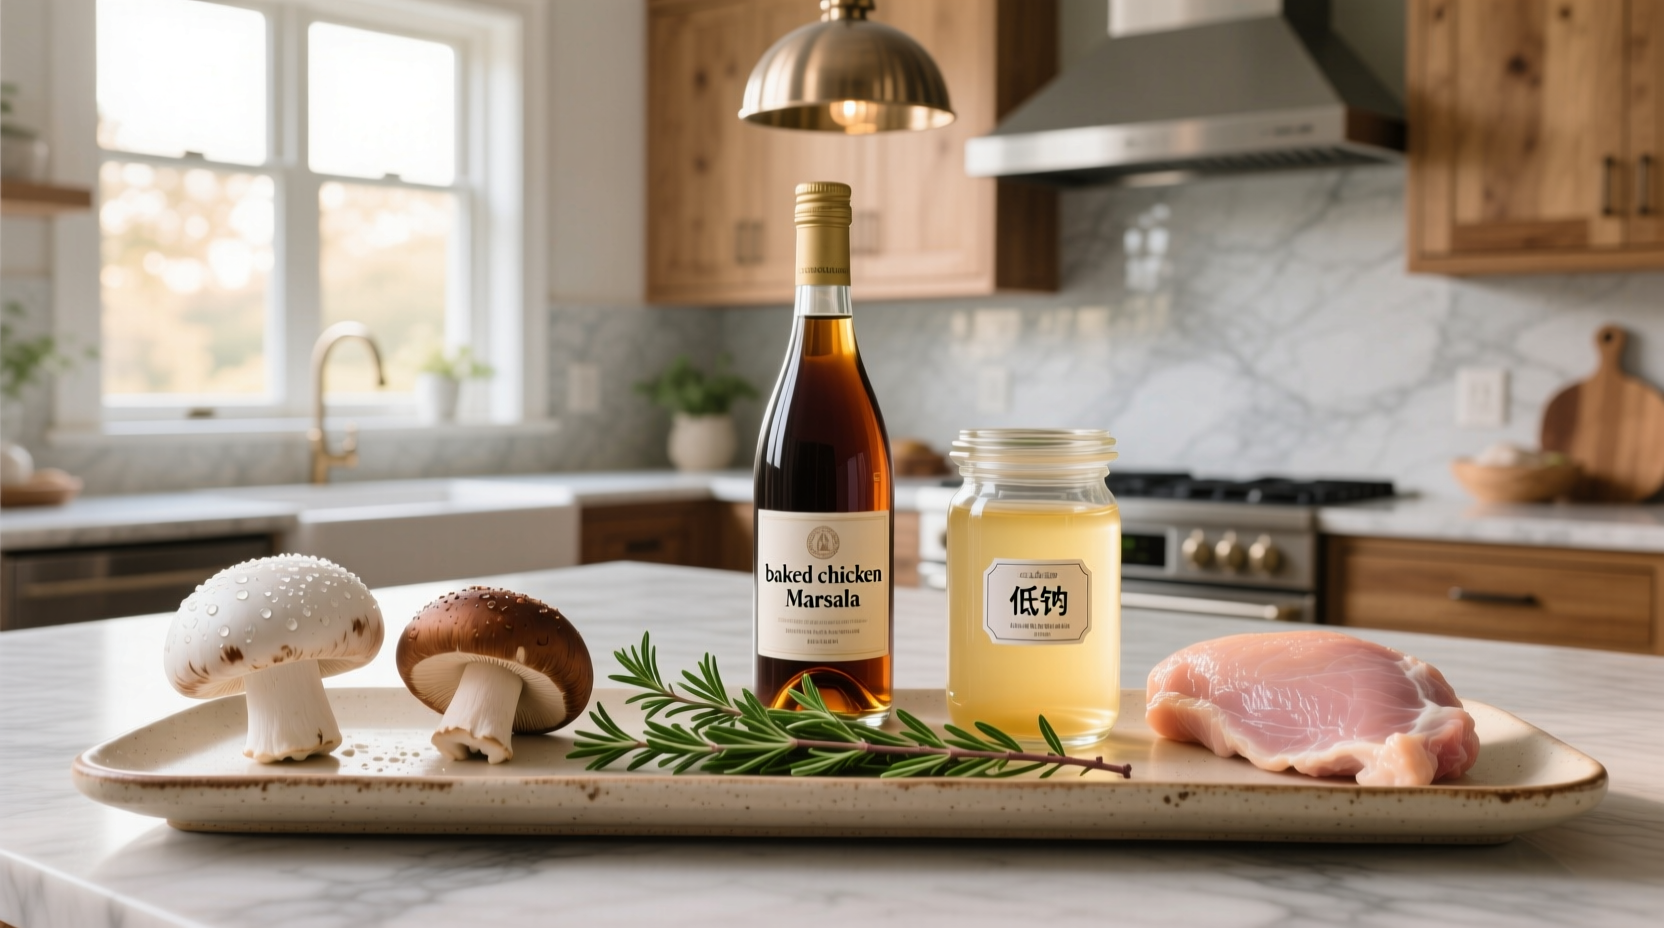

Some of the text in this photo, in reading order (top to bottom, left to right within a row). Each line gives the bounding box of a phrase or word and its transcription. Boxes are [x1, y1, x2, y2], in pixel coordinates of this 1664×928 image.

[765, 563, 882, 584] baked chicken
[785, 588, 861, 608] Marsala
